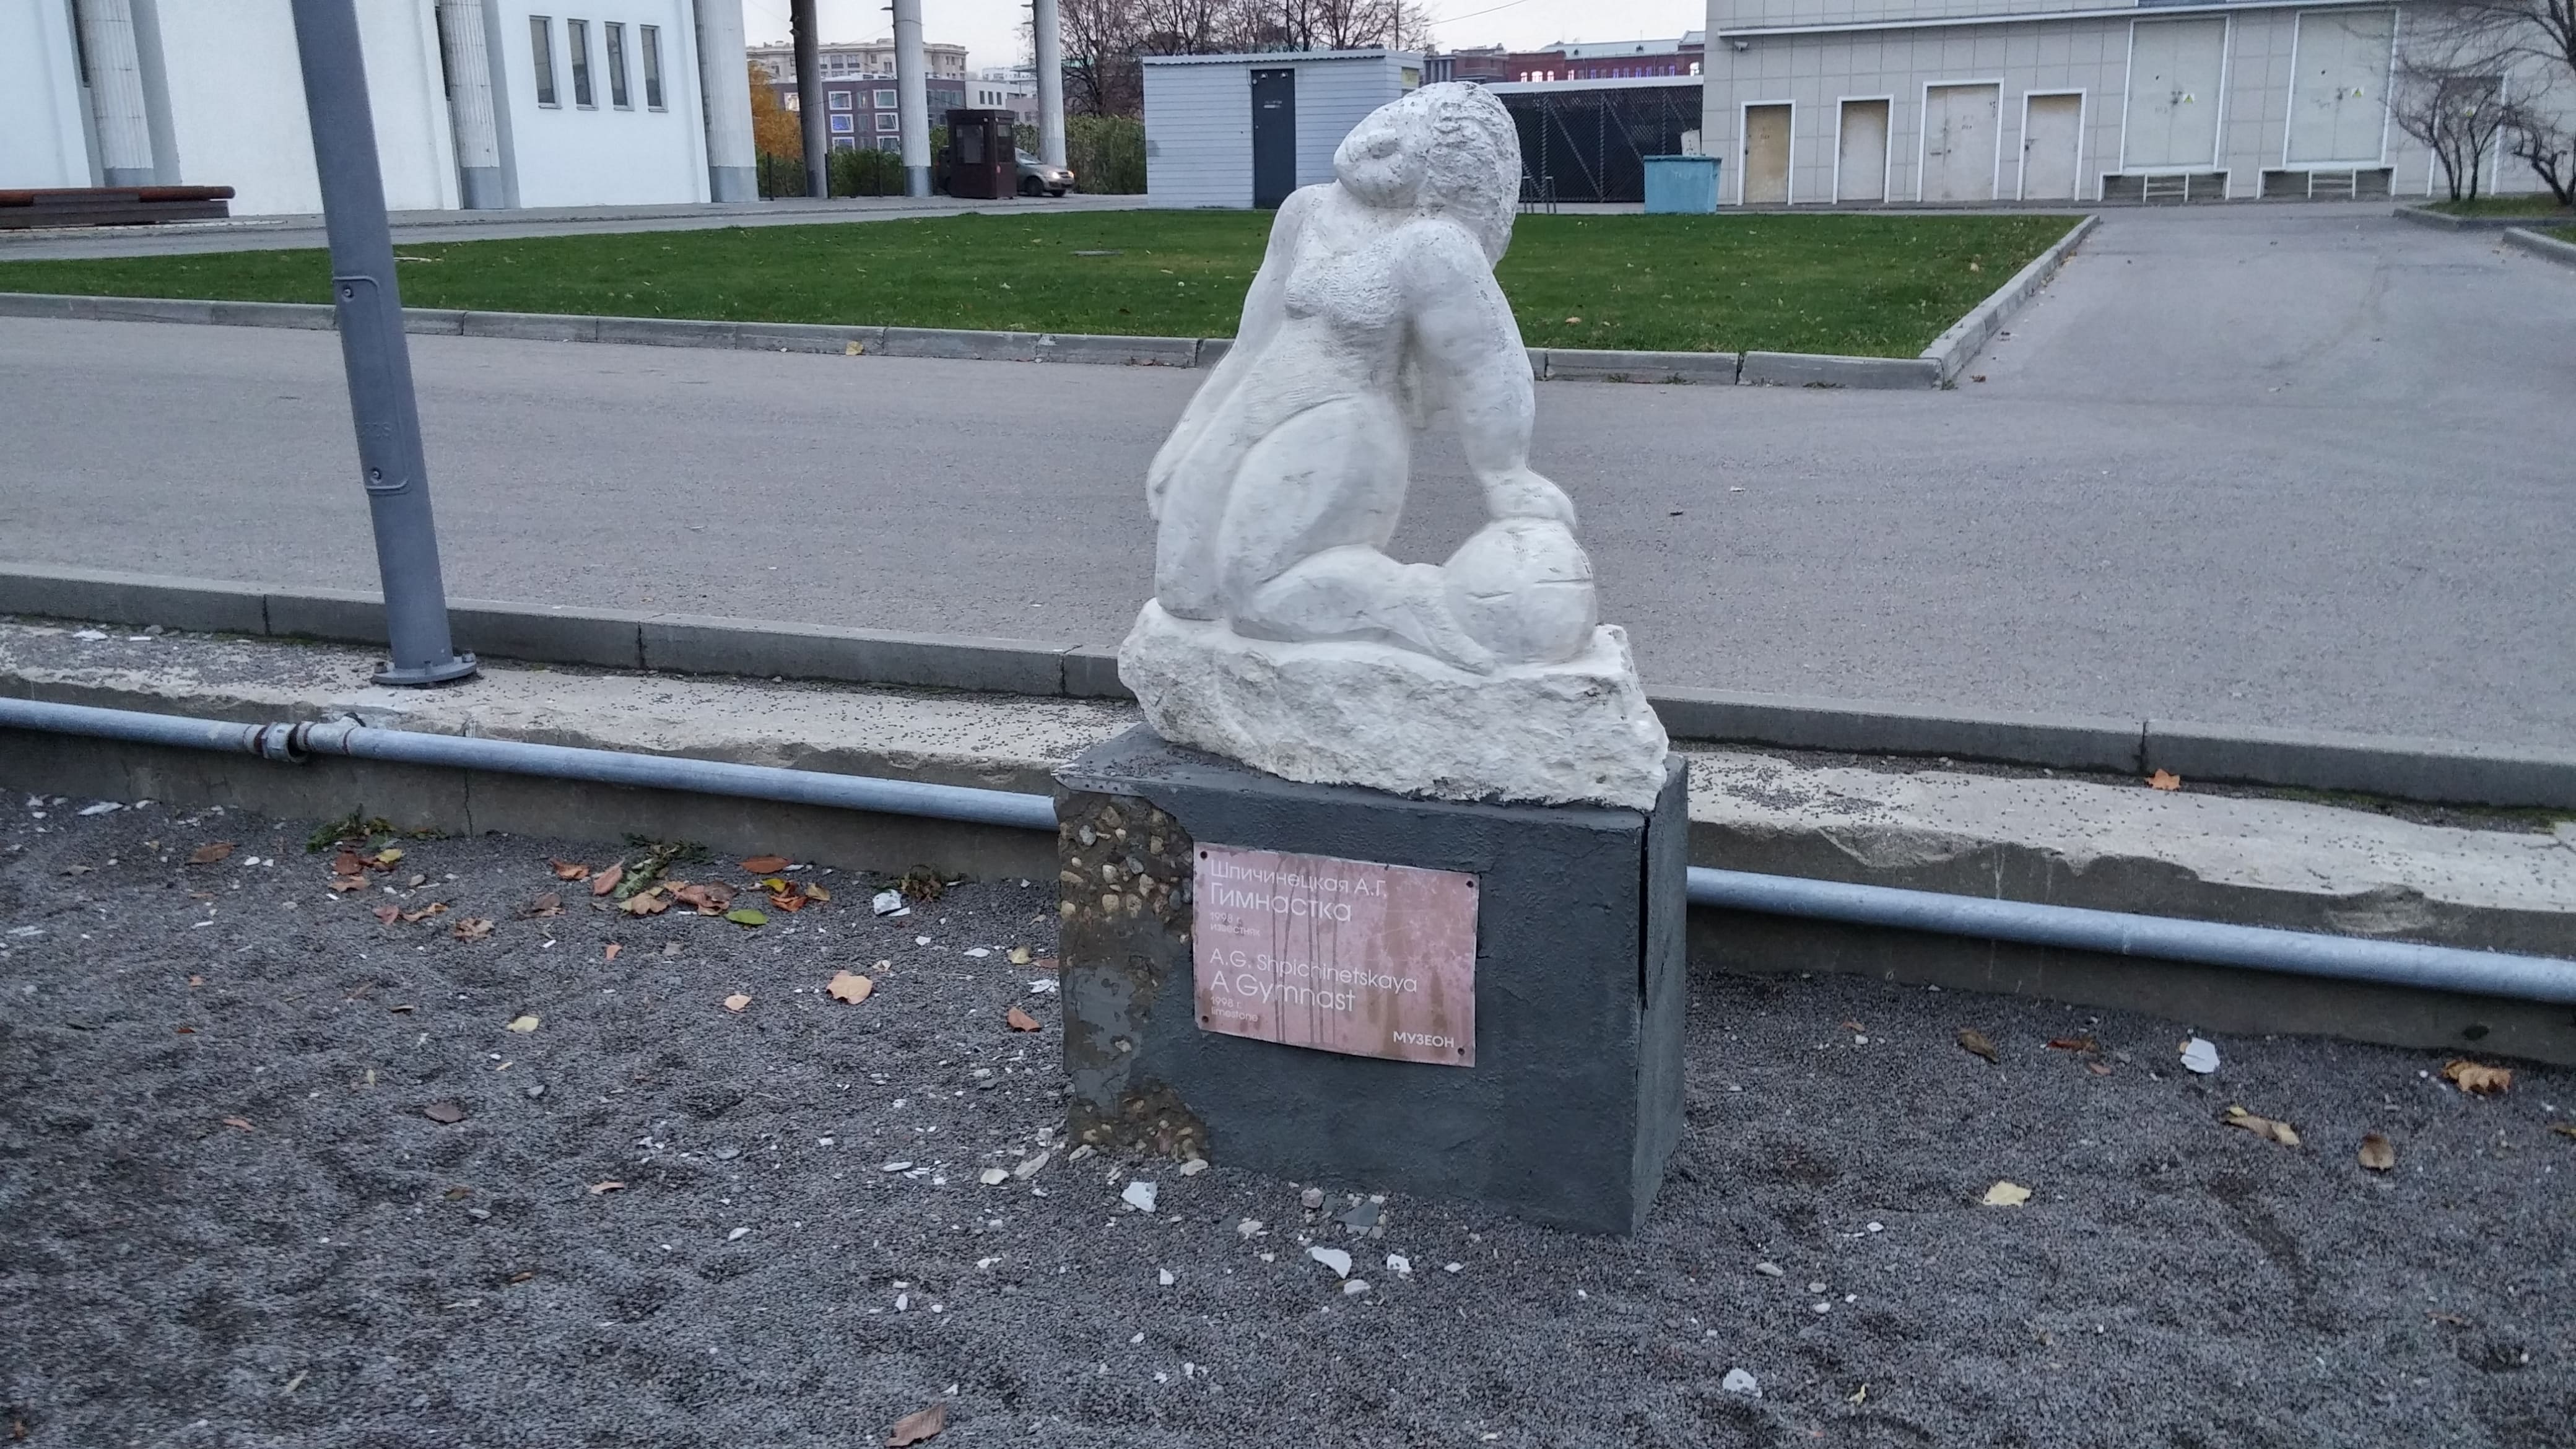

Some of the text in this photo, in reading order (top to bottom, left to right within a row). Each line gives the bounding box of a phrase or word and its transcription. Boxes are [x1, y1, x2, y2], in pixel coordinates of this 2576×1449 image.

[1211, 859, 1387, 898] Шпичинецкая А.Г.
[1211, 882, 1352, 922] Гимнастка
[1210, 911, 1234, 923] 1998
[1209, 947, 1417, 994] A.G. Shpichinetskaya
[1210, 970, 1356, 1012] A Gymnast
[1210, 996, 1234, 1008] 1998
[1211, 1006, 1258, 1022] limestone
[1393, 1030, 1455, 1048] МУЗЕОН
